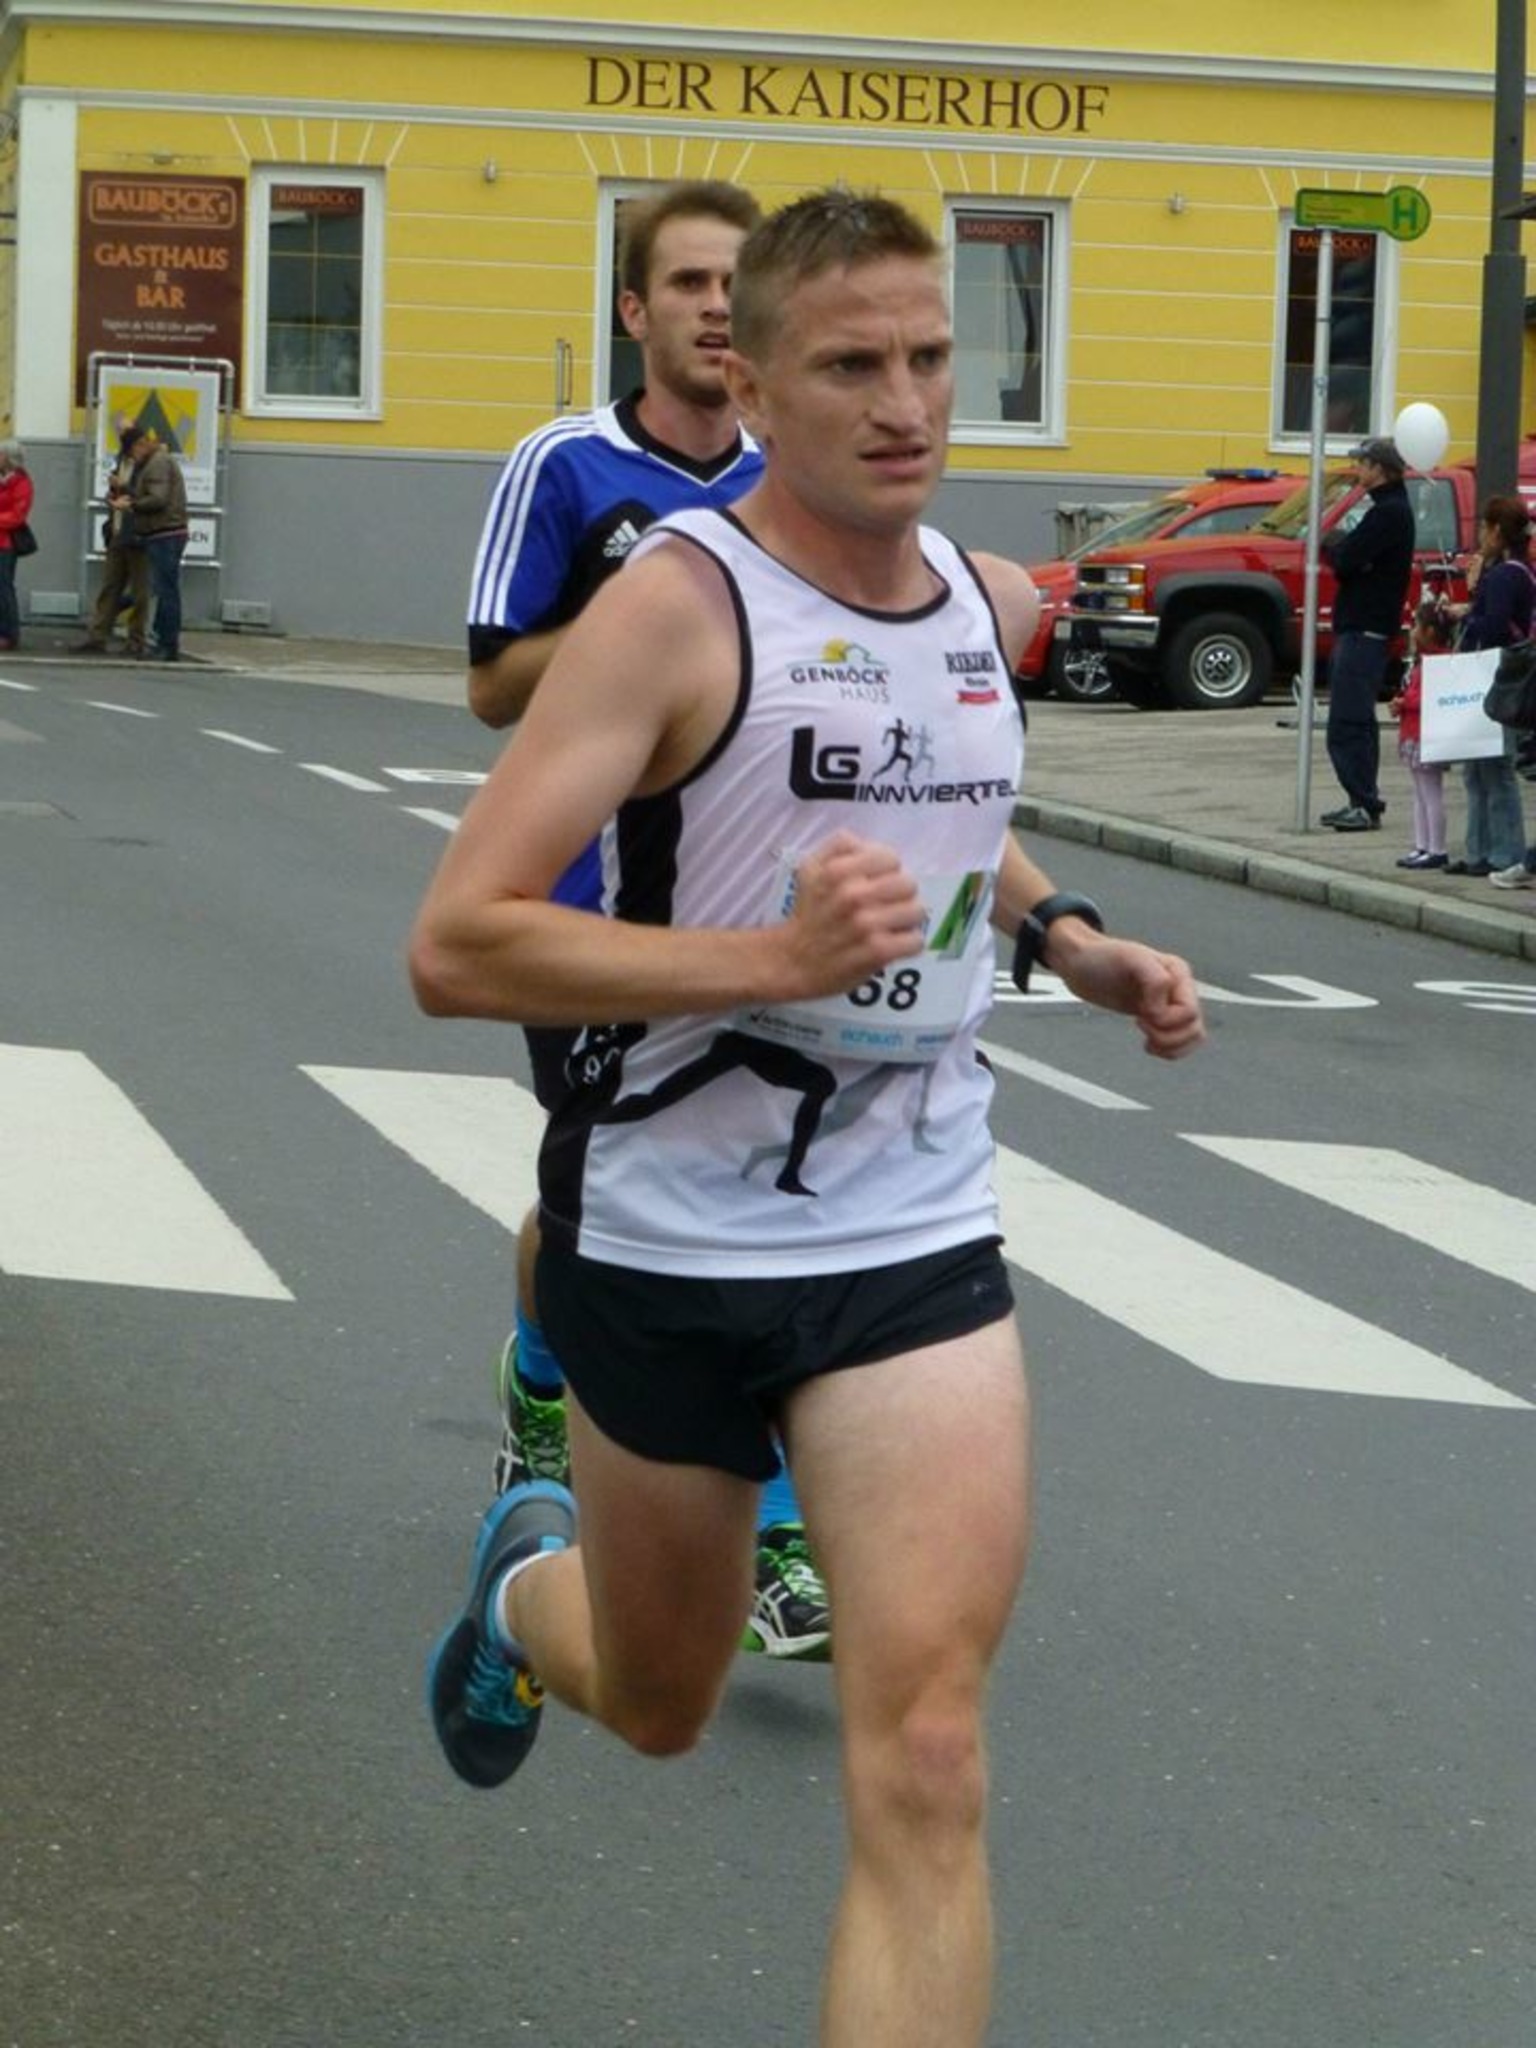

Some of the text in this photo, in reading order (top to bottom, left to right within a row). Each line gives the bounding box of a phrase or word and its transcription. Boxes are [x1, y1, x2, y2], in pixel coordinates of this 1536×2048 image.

[585, 57, 1110, 132] DER KAISERHOF
[1392, 196, 1417, 231] H
[95, 243, 229, 270] GASTHAUS
[135, 284, 186, 309] BAR
